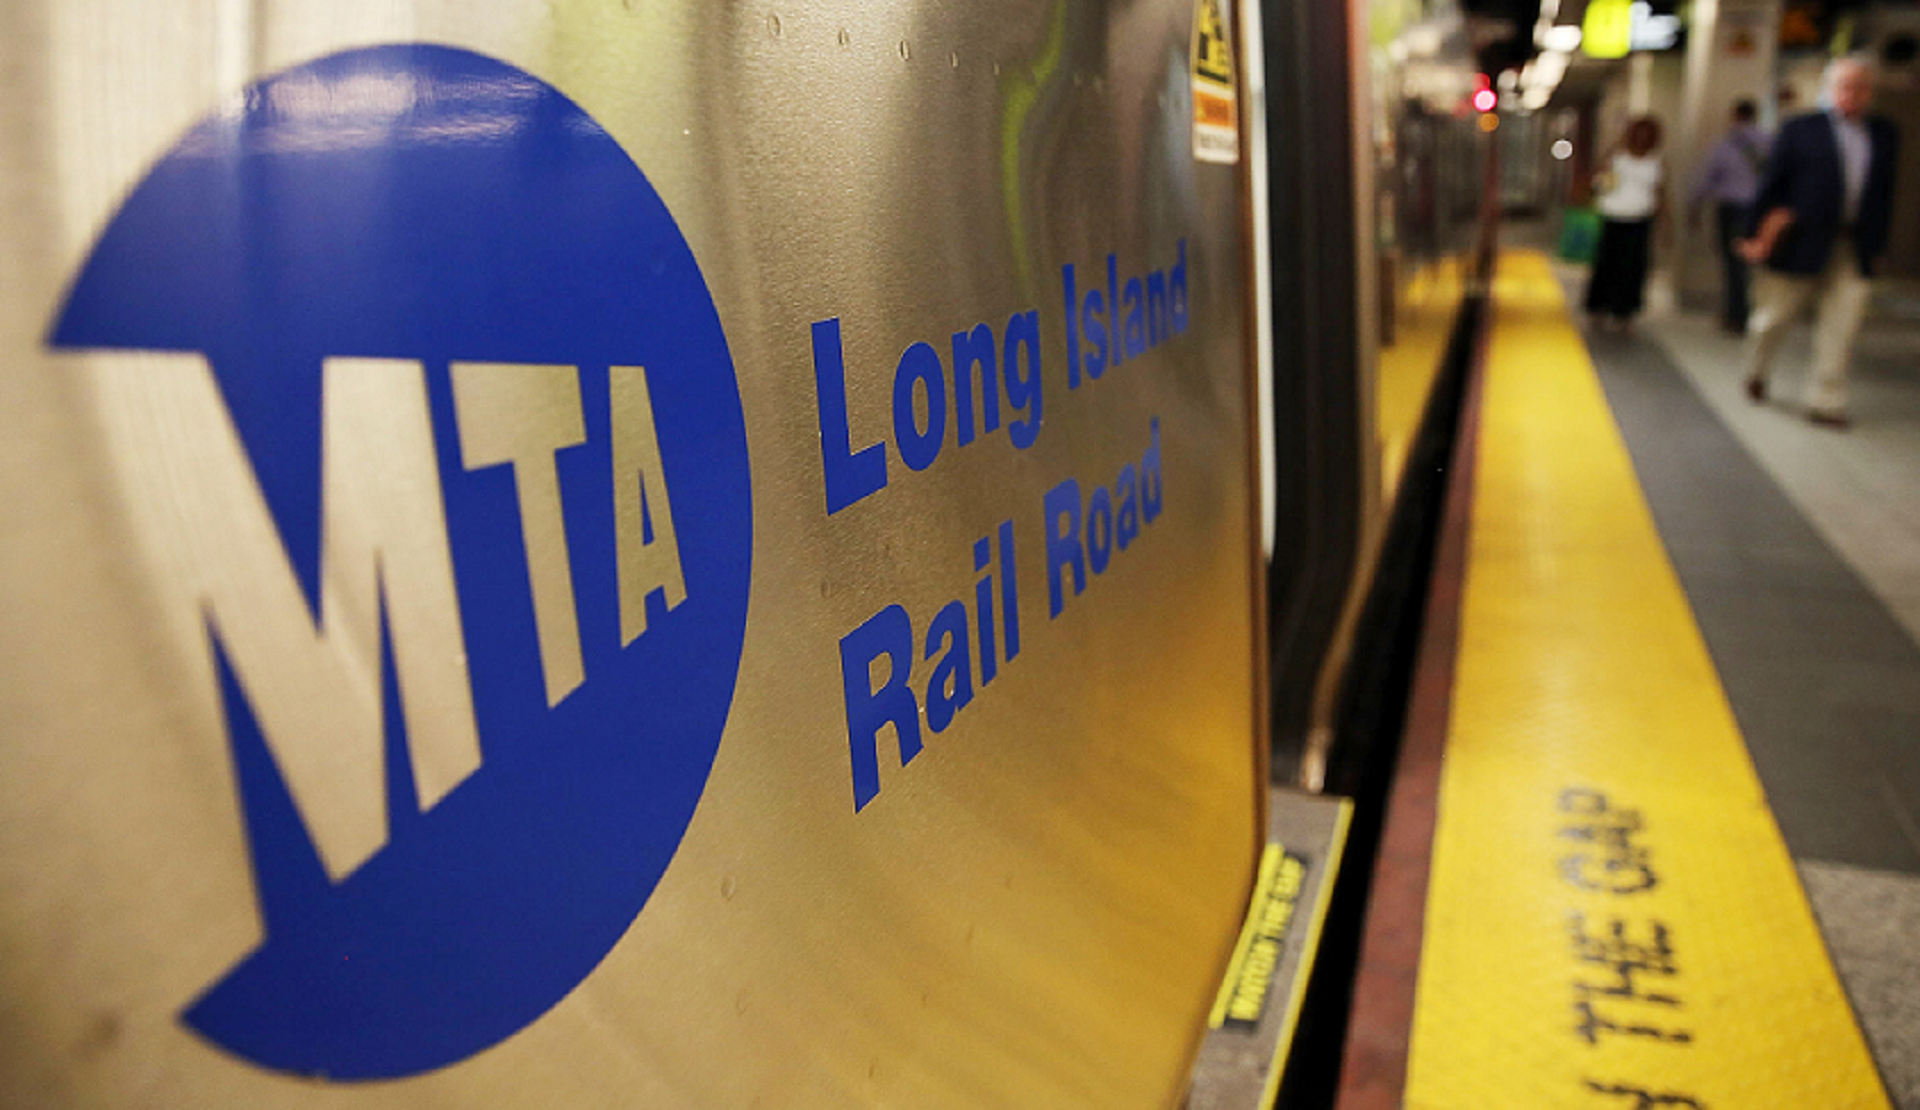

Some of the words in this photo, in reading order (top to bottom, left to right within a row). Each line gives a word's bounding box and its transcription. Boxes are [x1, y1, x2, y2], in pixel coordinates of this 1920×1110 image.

[811, 309, 1044, 516] Long
[1061, 237, 1189, 391] Island
[62, 346, 688, 960] MTA
[838, 518, 1020, 815] Rail
[1043, 416, 1163, 621] Road
[1555, 787, 1656, 893] GAP
[1566, 910, 1692, 1044] THE
